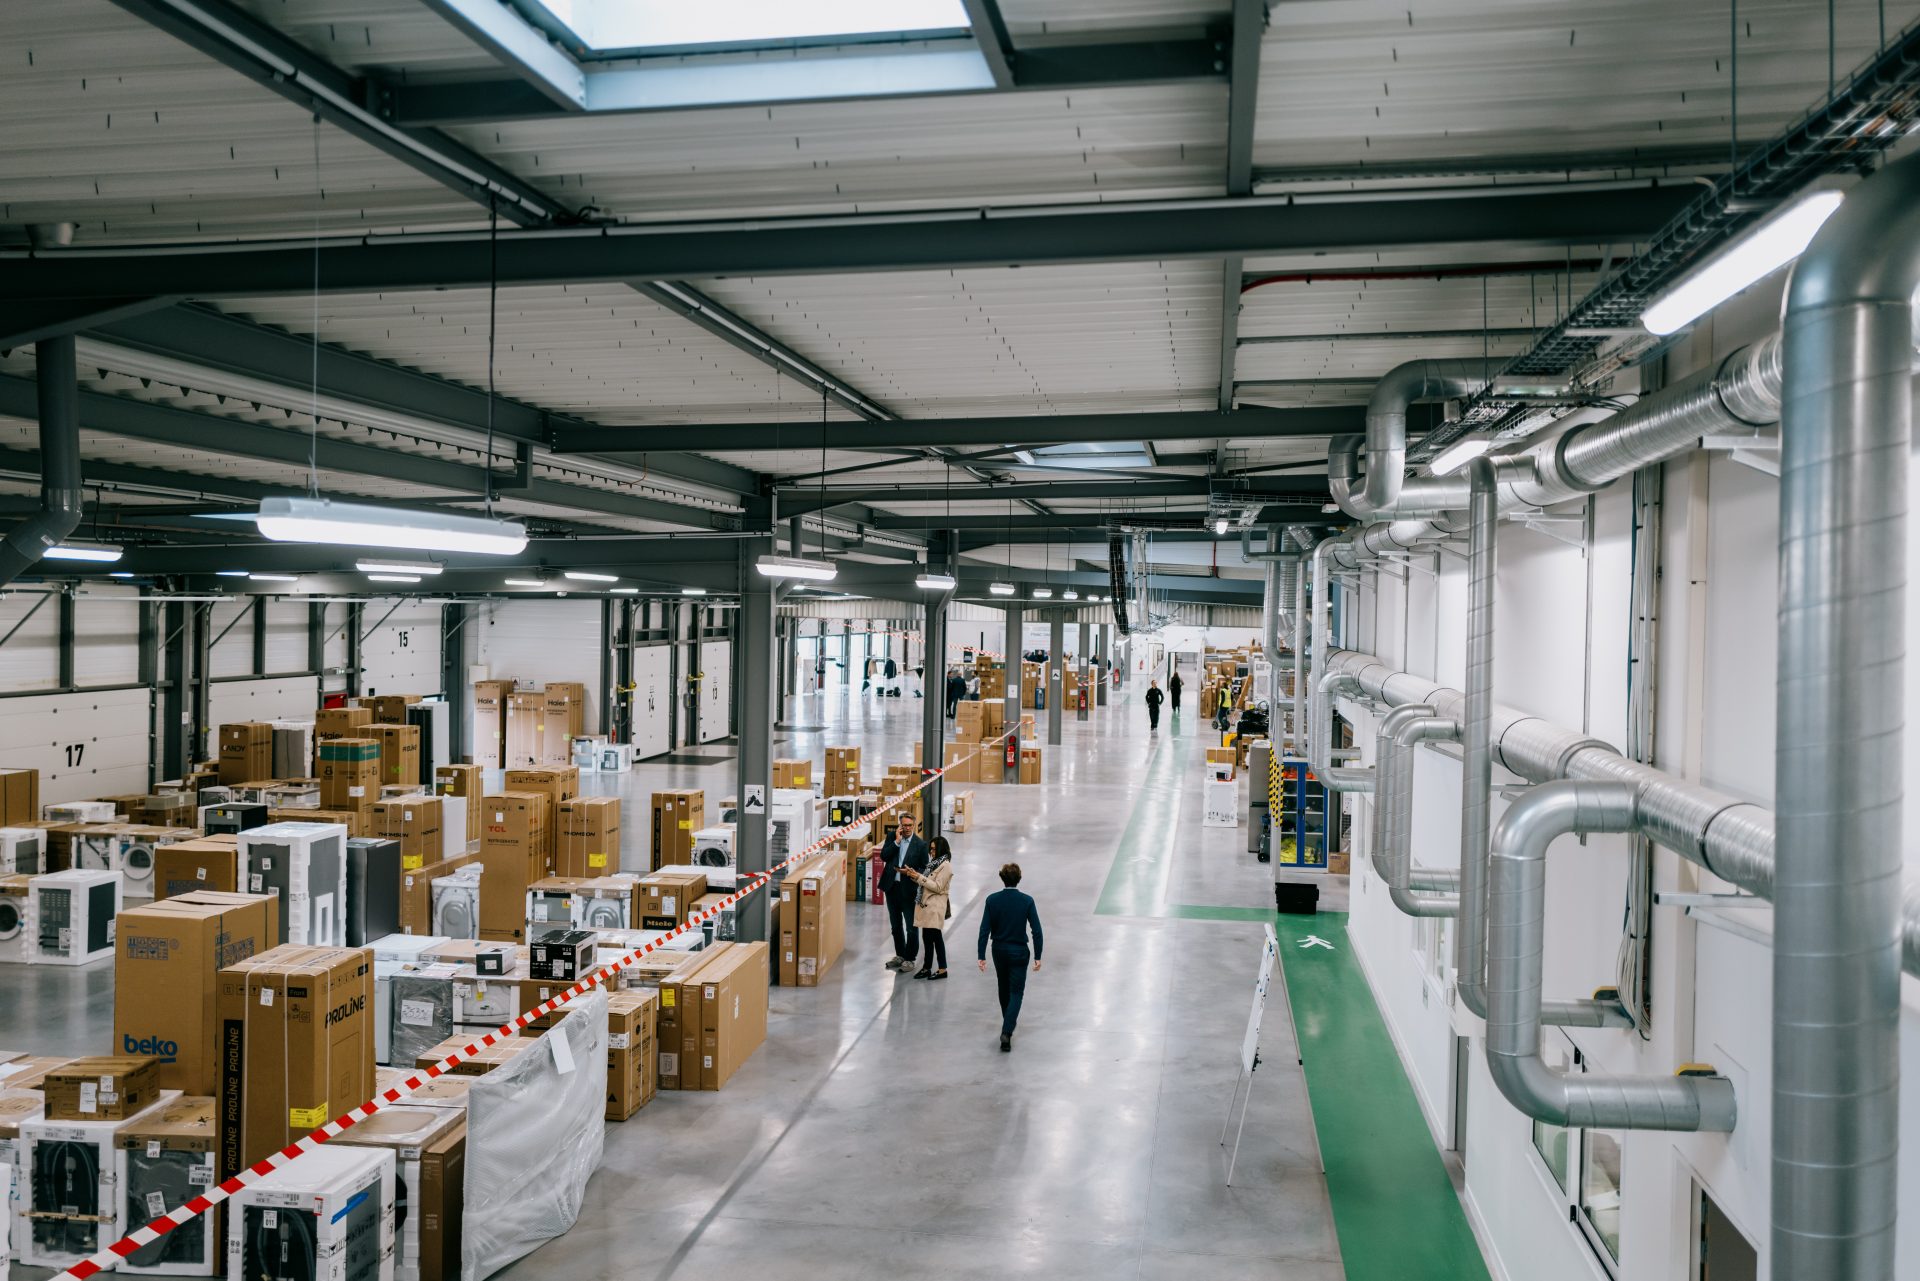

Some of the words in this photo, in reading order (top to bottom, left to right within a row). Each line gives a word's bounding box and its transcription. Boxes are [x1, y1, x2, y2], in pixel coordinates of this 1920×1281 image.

[399, 632, 408, 648] 15
[712, 688, 718, 700] 13
[648, 698, 654, 712] 14
[379, 715, 400, 724] Haier
[66, 744, 84, 768] 17
[124, 1034, 178, 1056] beko
